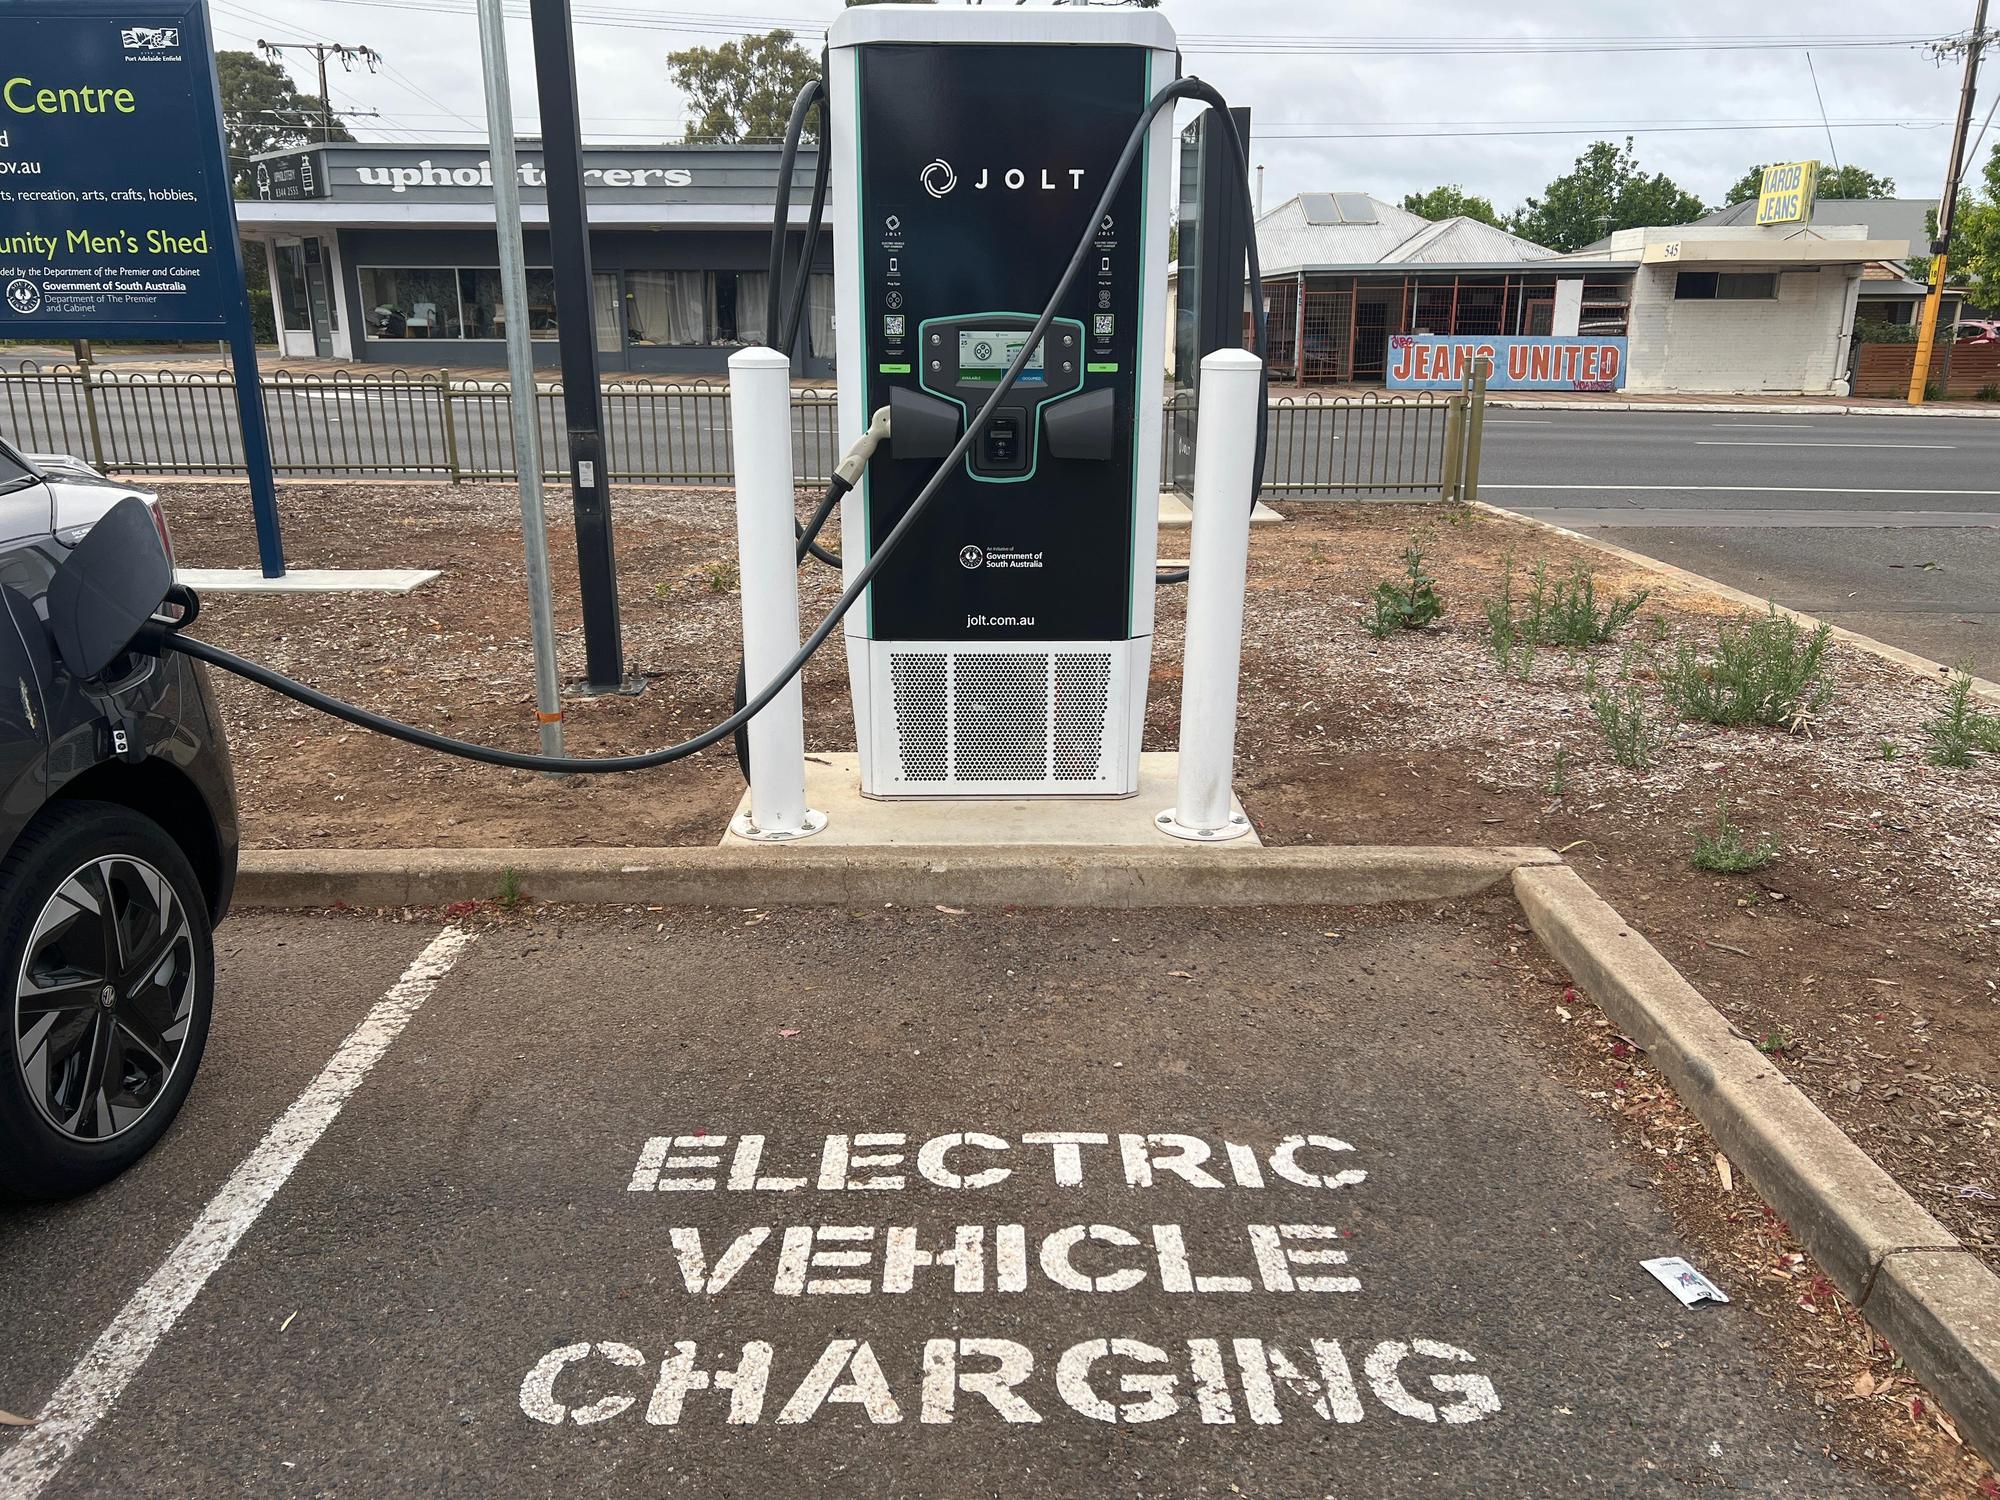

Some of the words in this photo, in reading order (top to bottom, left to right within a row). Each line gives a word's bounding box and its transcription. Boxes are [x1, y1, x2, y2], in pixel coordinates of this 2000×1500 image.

[3, 77, 136, 114] Centre
[0, 161, 42, 175] ov.au
[974, 168, 1085, 190] JOLT
[1763, 166, 1802, 194] KAROB
[17, 189, 79, 203] recreation,
[82, 190, 108, 203] arts,
[111, 188, 146, 203] crafts,
[149, 188, 198, 203] hobbies,
[1760, 194, 1799, 222] JEANS
[0, 231, 58, 261] unity
[66, 229, 139, 254] Men's
[146, 229, 209, 254] Shed
[1664, 243, 1679, 258] 545
[0, 267, 15, 276] ded
[16, 267, 26, 278] by
[28, 267, 42, 276] the
[44, 266, 92, 278] Department
[94, 266, 104, 277] of
[104, 267, 118, 276] the
[120, 267, 150, 276] Premier
[152, 267, 168, 277] and
[170, 267, 201, 277] Cabinet
[42, 281, 101, 292] Government
[102, 280, 113, 291] of
[115, 281, 144, 291] South
[145, 281, 187, 292] Australia
[44, 294, 93, 305] Department
[94, 294, 105, 304] of
[106, 294, 124, 304] The
[125, 294, 157, 304] Premier
[46, 304, 62, 312] and
[63, 304, 96, 312] Cabinet
[1392, 345, 1496, 381] JEANS
[1507, 345, 1620, 382] UNITED
[986, 552, 1033, 560] Government
[1034, 552, 1043, 560] of
[986, 560, 1008, 568] South
[1010, 560, 1043, 568] Australia
[966, 614, 1035, 628] jolt.com.au
[627, 1132, 1368, 1194] ELECTRIC
[669, 1223, 1363, 1296] VEHICLE
[518, 1337, 1500, 1427] CHARGING
